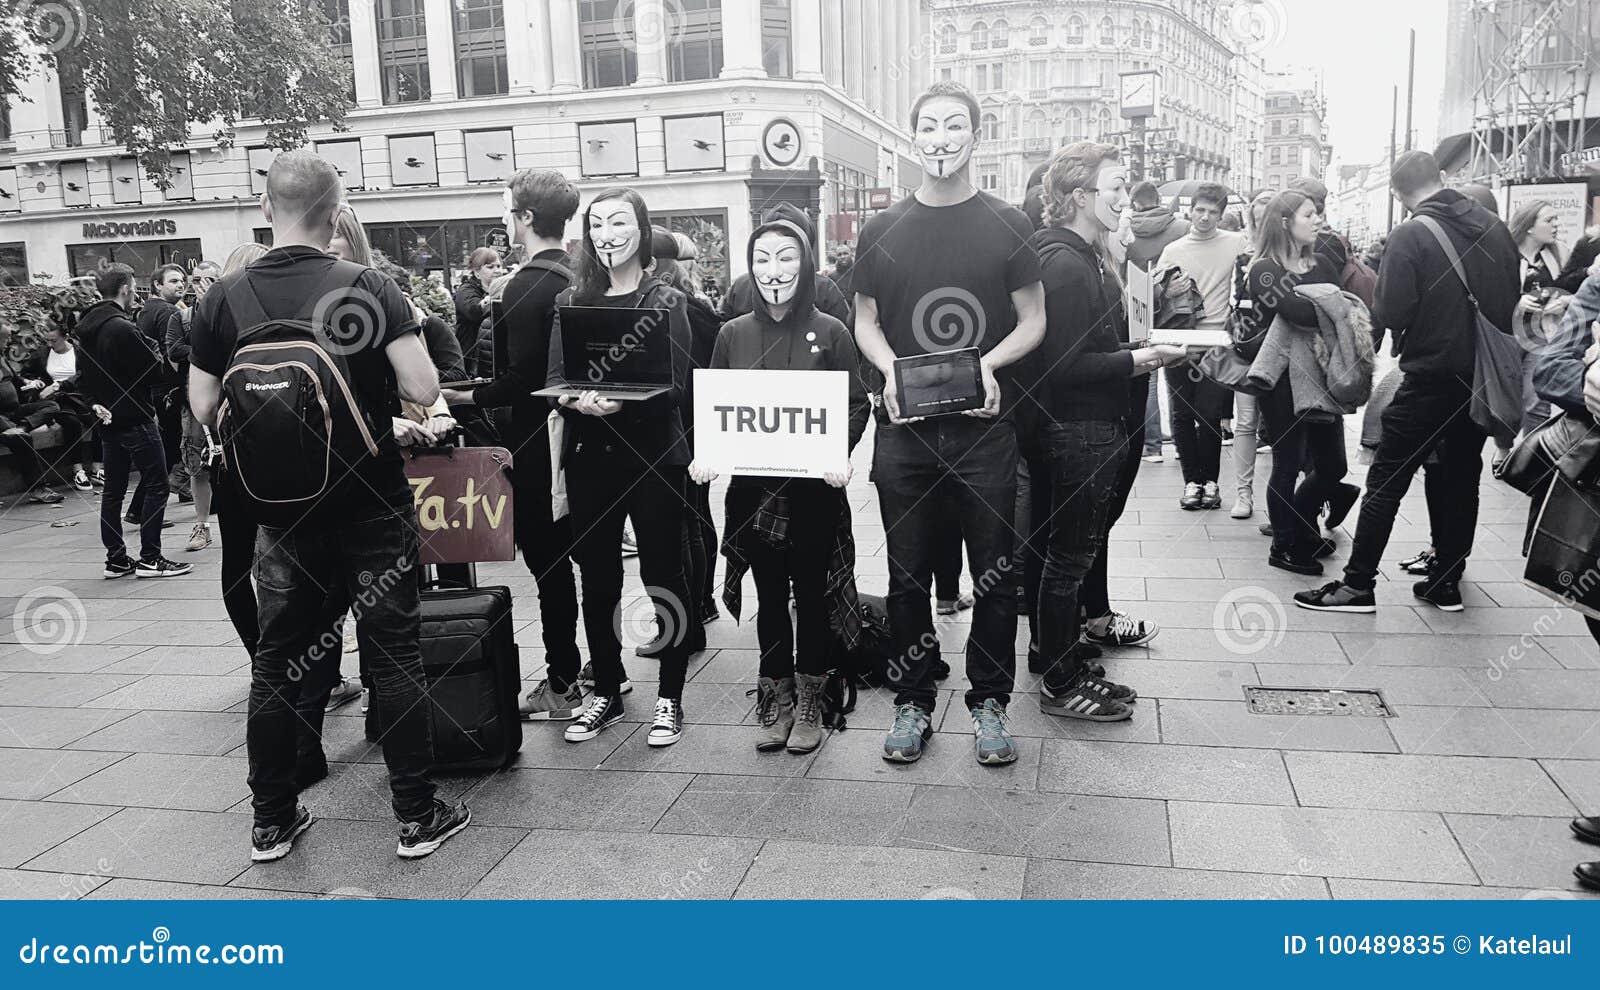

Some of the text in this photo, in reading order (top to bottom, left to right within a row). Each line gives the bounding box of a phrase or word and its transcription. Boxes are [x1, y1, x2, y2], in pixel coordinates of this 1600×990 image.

[82, 218, 177, 239] McDonald's
[252, 379, 292, 391] WENGER
[713, 405, 827, 435] TRUTH
